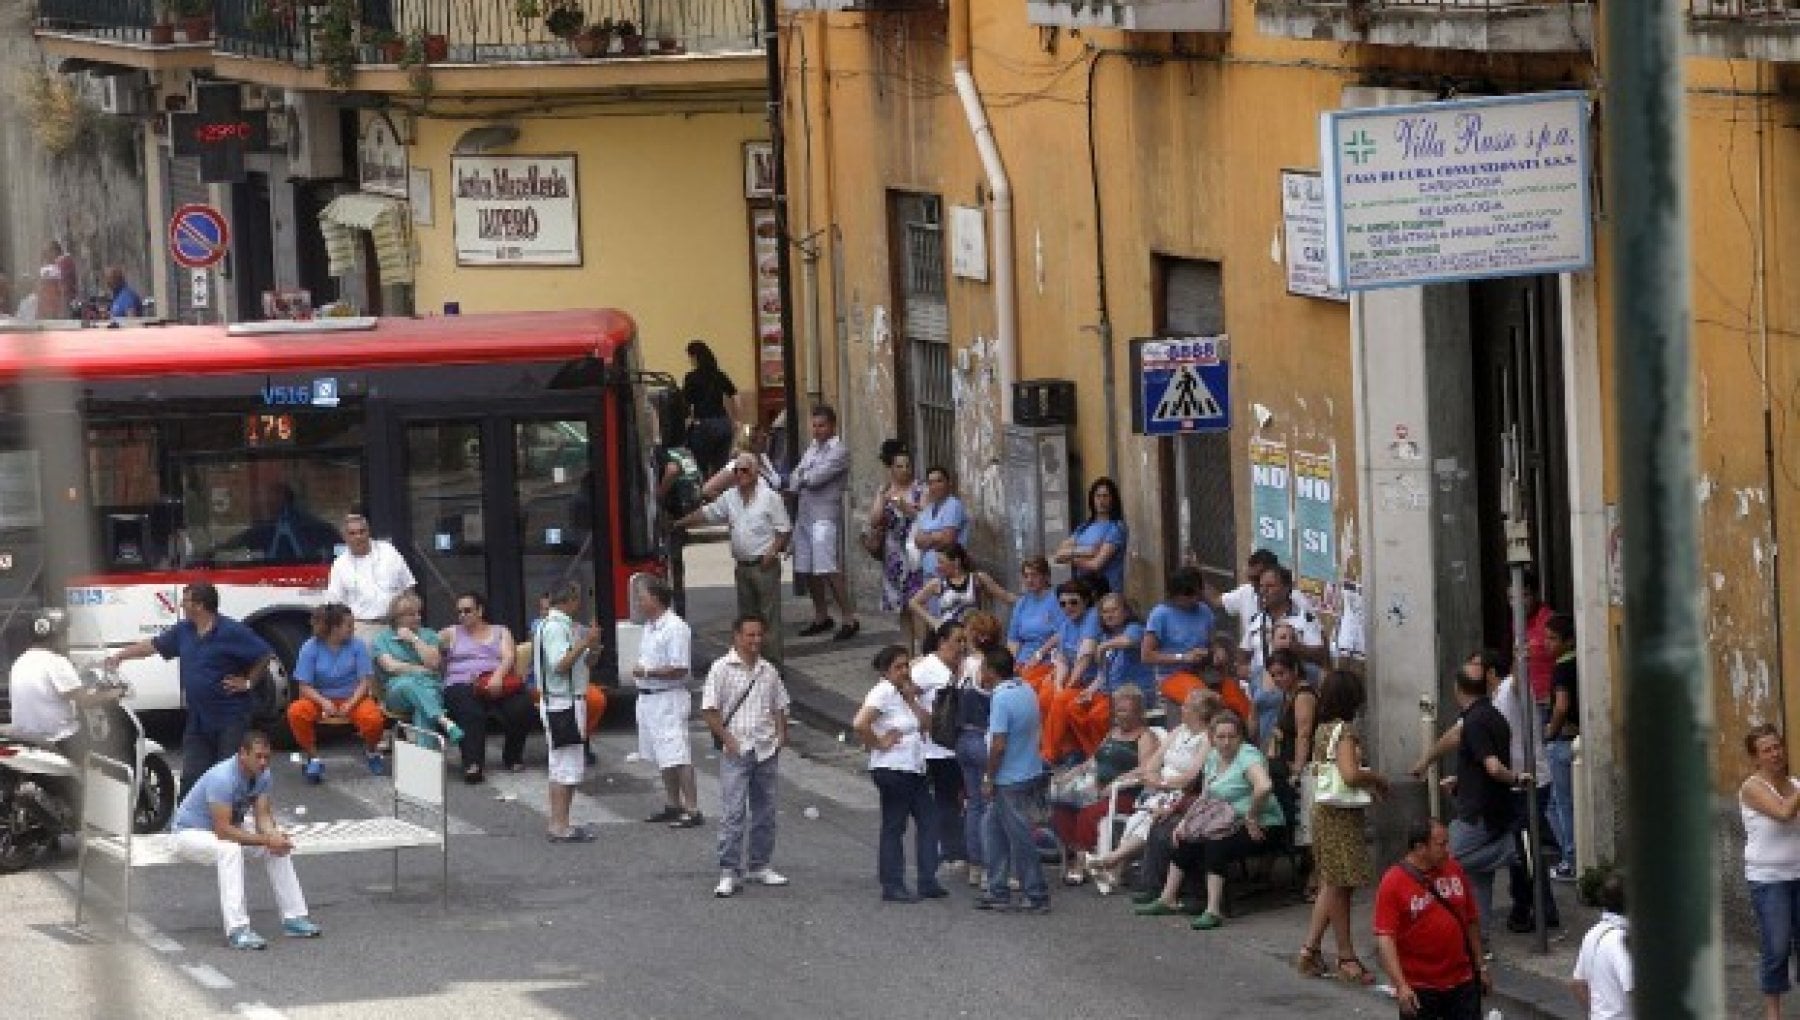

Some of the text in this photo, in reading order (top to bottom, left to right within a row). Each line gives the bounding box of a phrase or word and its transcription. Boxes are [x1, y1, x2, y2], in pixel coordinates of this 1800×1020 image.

[1394, 117, 1446, 160] Villa
[1346, 173, 1377, 184] CASA
[1381, 170, 1395, 181] DI
[1399, 167, 1435, 180] CURA
[260, 386, 310, 405] V516
[1259, 516, 1284, 541] SI
[1303, 528, 1328, 555] SI
